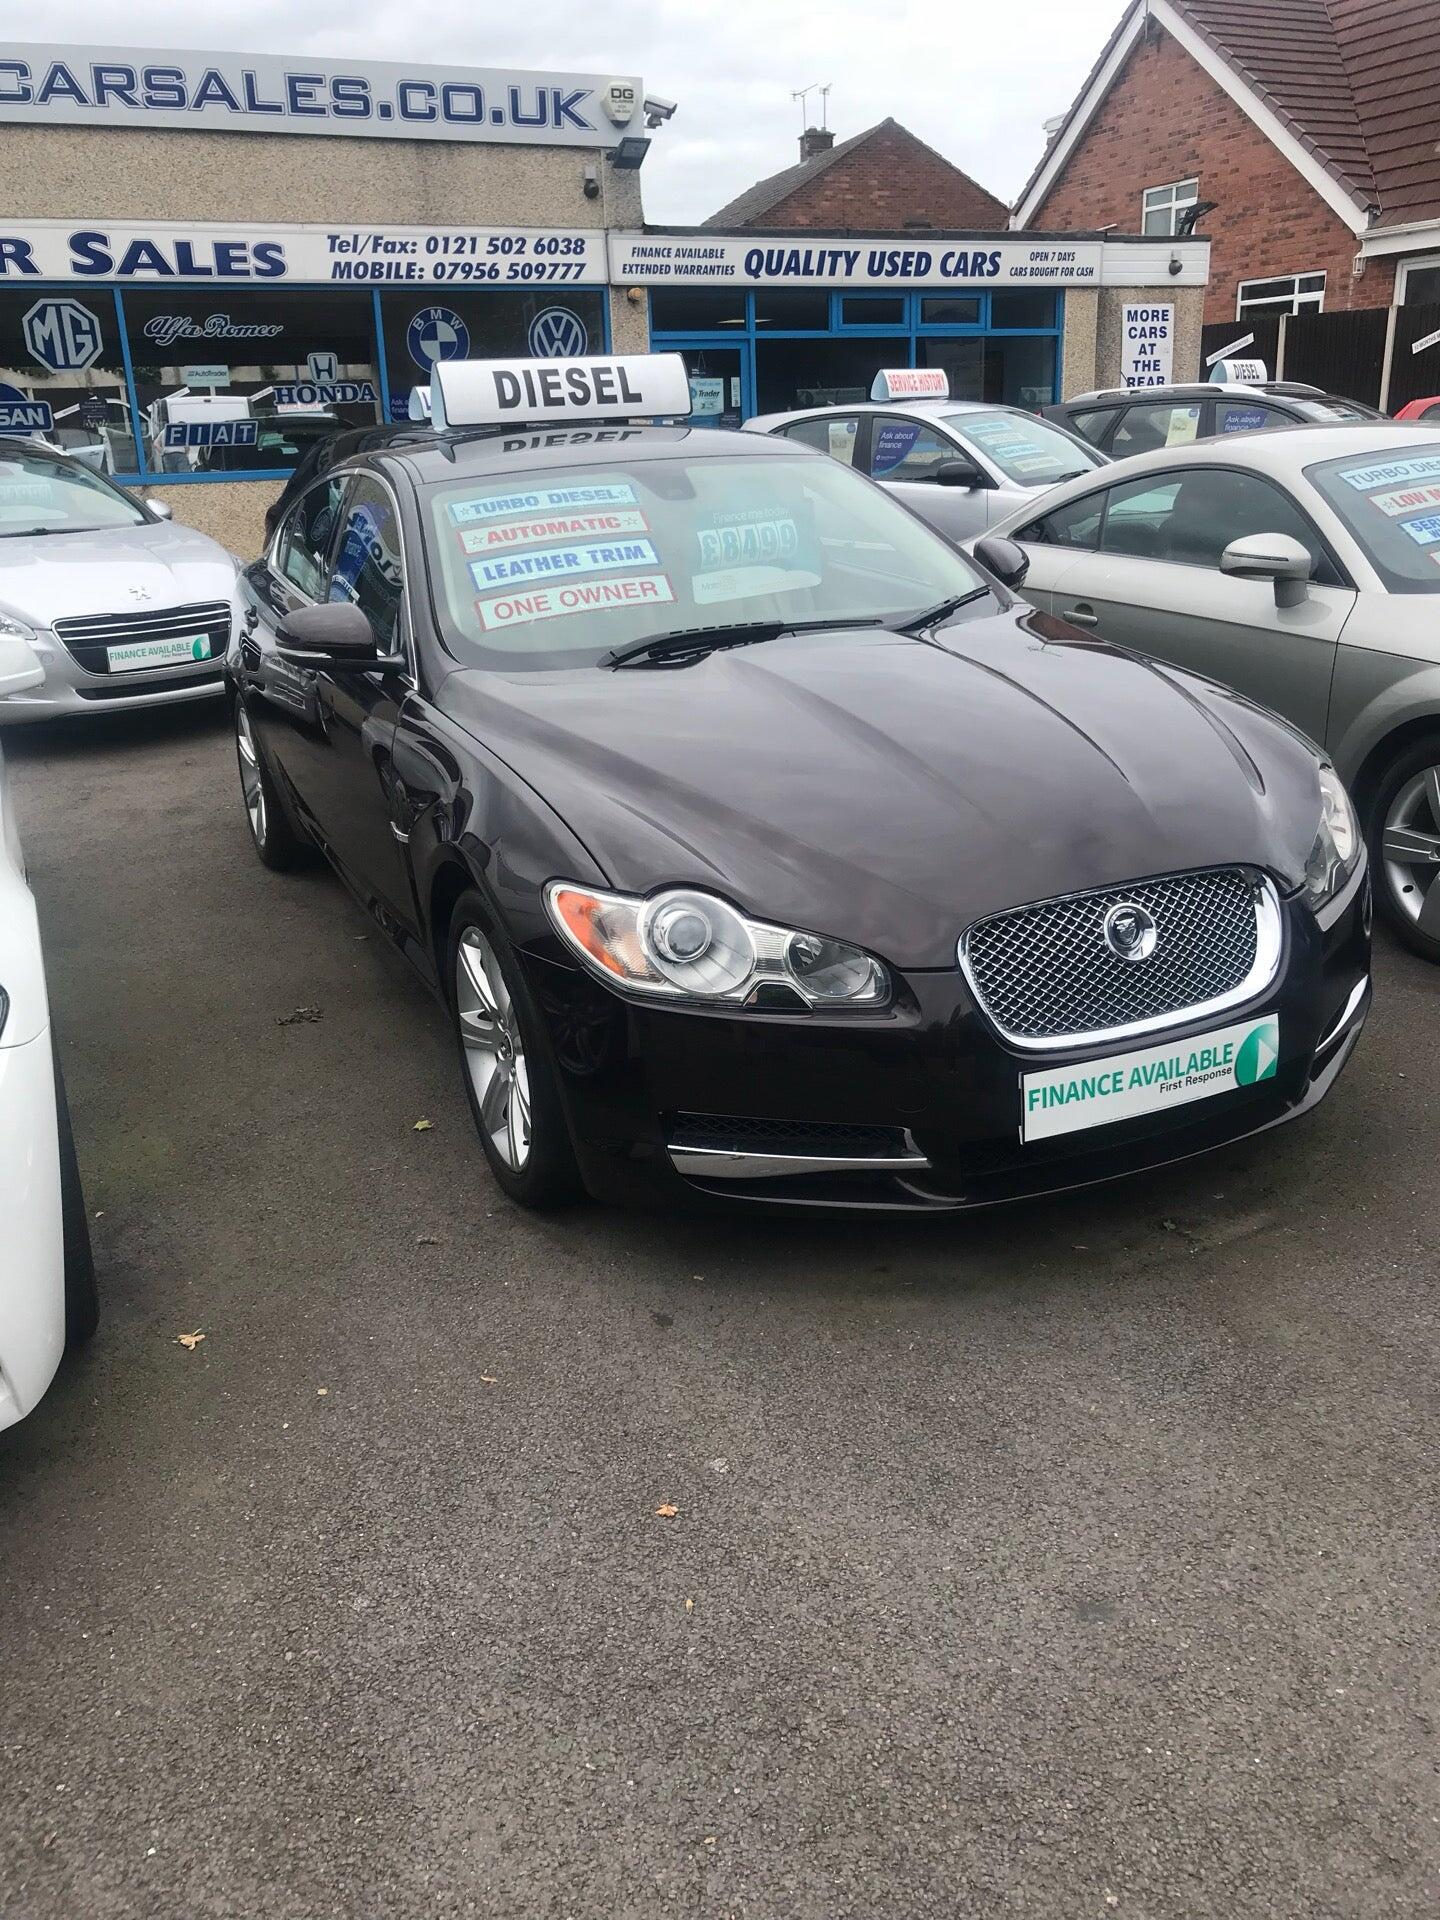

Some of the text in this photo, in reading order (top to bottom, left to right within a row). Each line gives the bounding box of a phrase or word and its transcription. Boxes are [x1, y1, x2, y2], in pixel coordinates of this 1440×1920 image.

[611, 88, 634, 99] DG
[67, 230, 289, 277] SALES
[327, 235, 586, 256] Tel/Fax: 0121 502 6038
[631, 247, 725, 259] FINANCE AVAILABLE
[744, 249, 1002, 279] QUALITY USED CARS
[1029, 251, 1076, 262] OPEN 7 DAYS
[331, 261, 587, 280] MOBILE: 07956 509777
[622, 264, 735, 276] EXTENDED WARRANTIES
[1009, 267, 1094, 277] CARS BOUGHT FOR CASH
[411, 308, 464, 331] BMW
[1127, 309, 1169, 322] MORE
[32, 305, 98, 369] MG
[144, 313, 284, 346] Alfa Romeo
[1128, 327, 1167, 339] CARS
[1138, 344, 1156, 355] AT
[1132, 360, 1161, 372] THE
[1233, 363, 1260, 380] DIESEL
[493, 366, 643, 409] DIESEL
[888, 373, 945, 391] SERVICE HISTORY
[1127, 376, 1165, 387] REAR
[274, 384, 377, 404] HONDA
[699, 389, 720, 397] Trader
[169, 425, 253, 445] FIAT
[881, 432, 914, 440] Ask about
[879, 441, 902, 449] finance
[1346, 464, 1409, 485] TURBO
[470, 489, 620, 515] TURBO DIESEL
[1390, 489, 1428, 508] LOW
[487, 516, 621, 544] AUTOMATIC
[483, 545, 646, 581] LEATHER TRIM
[494, 581, 659, 620] ONE OWNER
[109, 642, 191, 661] FINANCE AVAILABLE
[1028, 1042, 1234, 1111] FINANCE AVAILABLE
[1160, 1067, 1233, 1094] First Response
